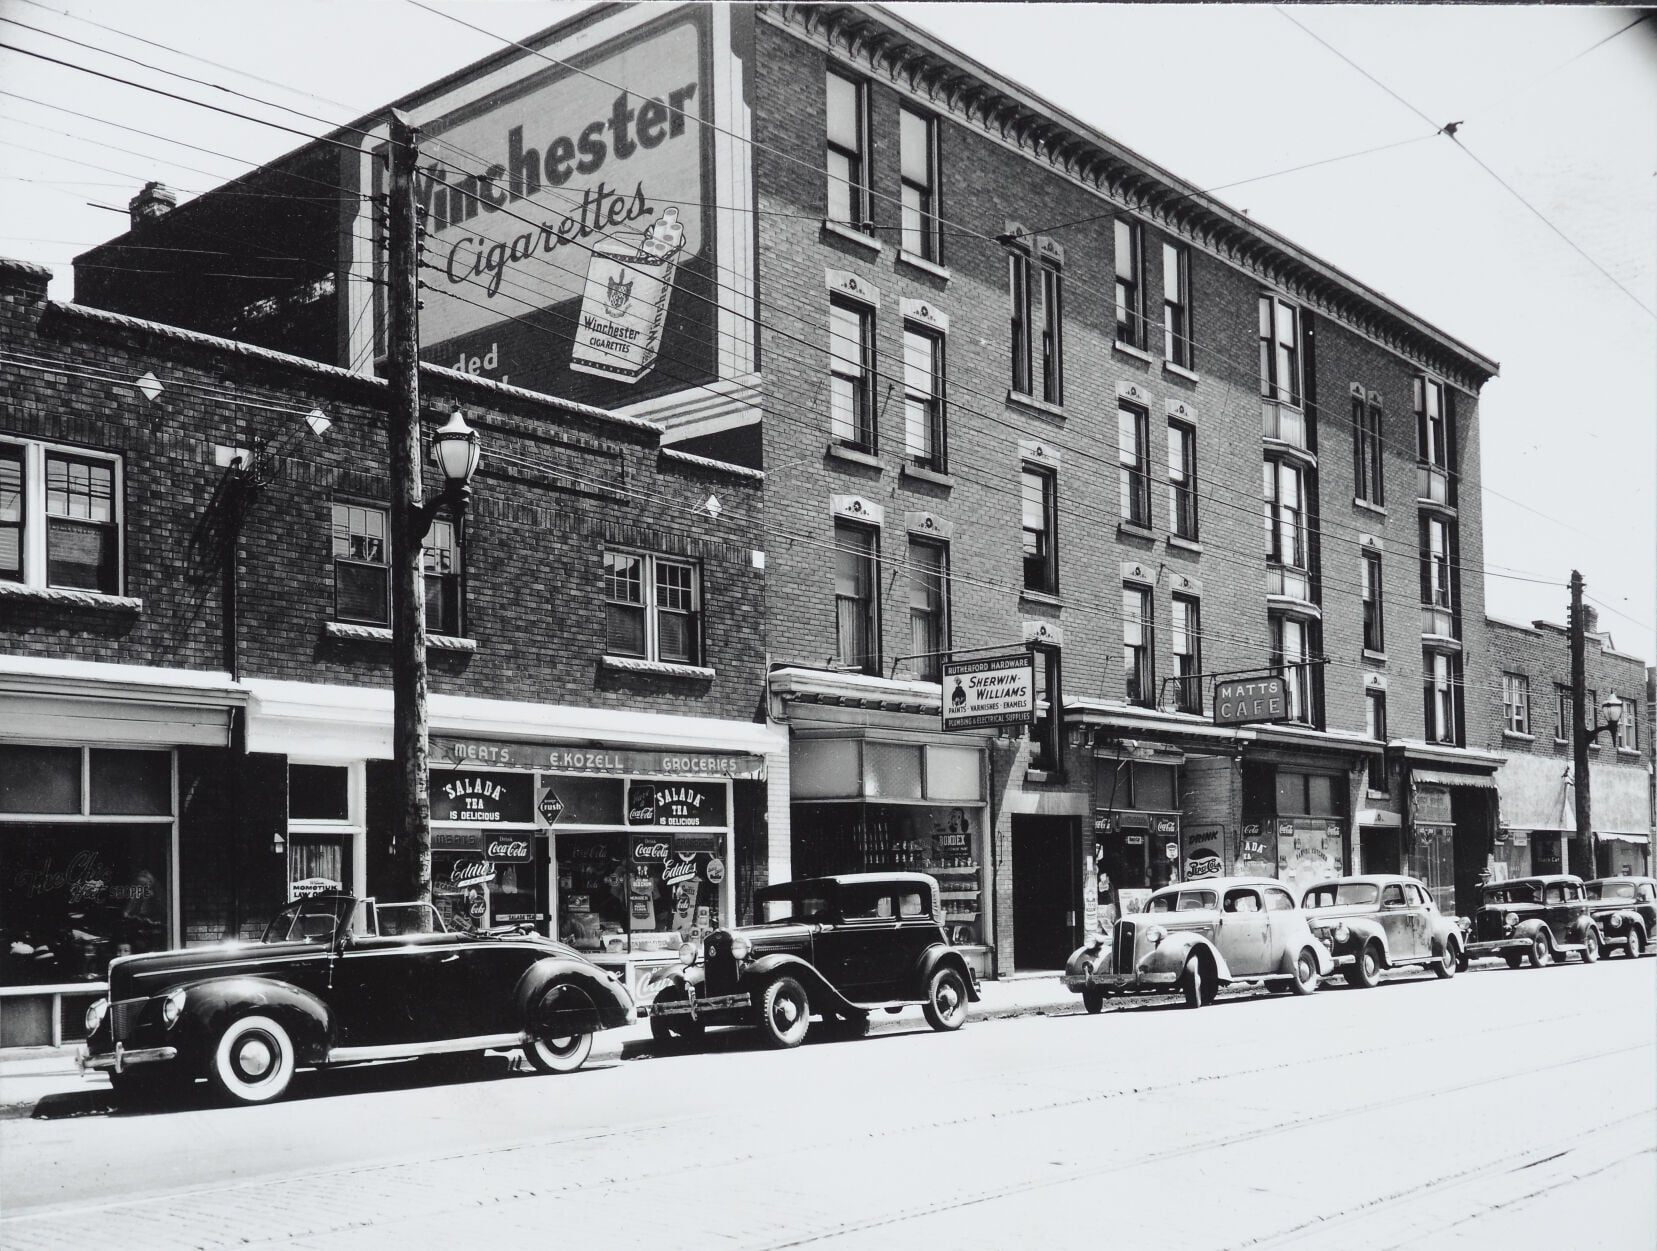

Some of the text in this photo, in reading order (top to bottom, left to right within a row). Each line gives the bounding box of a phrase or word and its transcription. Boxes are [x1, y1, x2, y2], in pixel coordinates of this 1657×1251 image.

[446, 180, 654, 298] Cigarettes
[584, 315, 640, 341] Winchester
[590, 337, 630, 354] CIGARETTES
[948, 658, 1028, 674] RUTHERFORD HARDWARE
[976, 686, 1026, 700] WILLIAMS
[1222, 682, 1278, 698] MATTS
[948, 700, 1026, 714] PAINTS VARNISHES ENAMELS
[1220, 698, 1280, 718] CAFE
[948, 718, 972, 726] PLUMBING
[977, 715, 1004, 724] ELECTRICAL
[1006, 712, 1030, 720] SUPPLIES
[662, 758, 737, 771] GROCERIES
[466, 798, 484, 809] TEA
[540, 802, 560, 812] Crush
[672, 805, 688, 815] TEA
[450, 810, 500, 820] IS DELICIOUS
[668, 818, 700, 826] DELICIOUS
[1189, 830, 1218, 844] DRINK
[110, 885, 154, 899] SHOPPE
